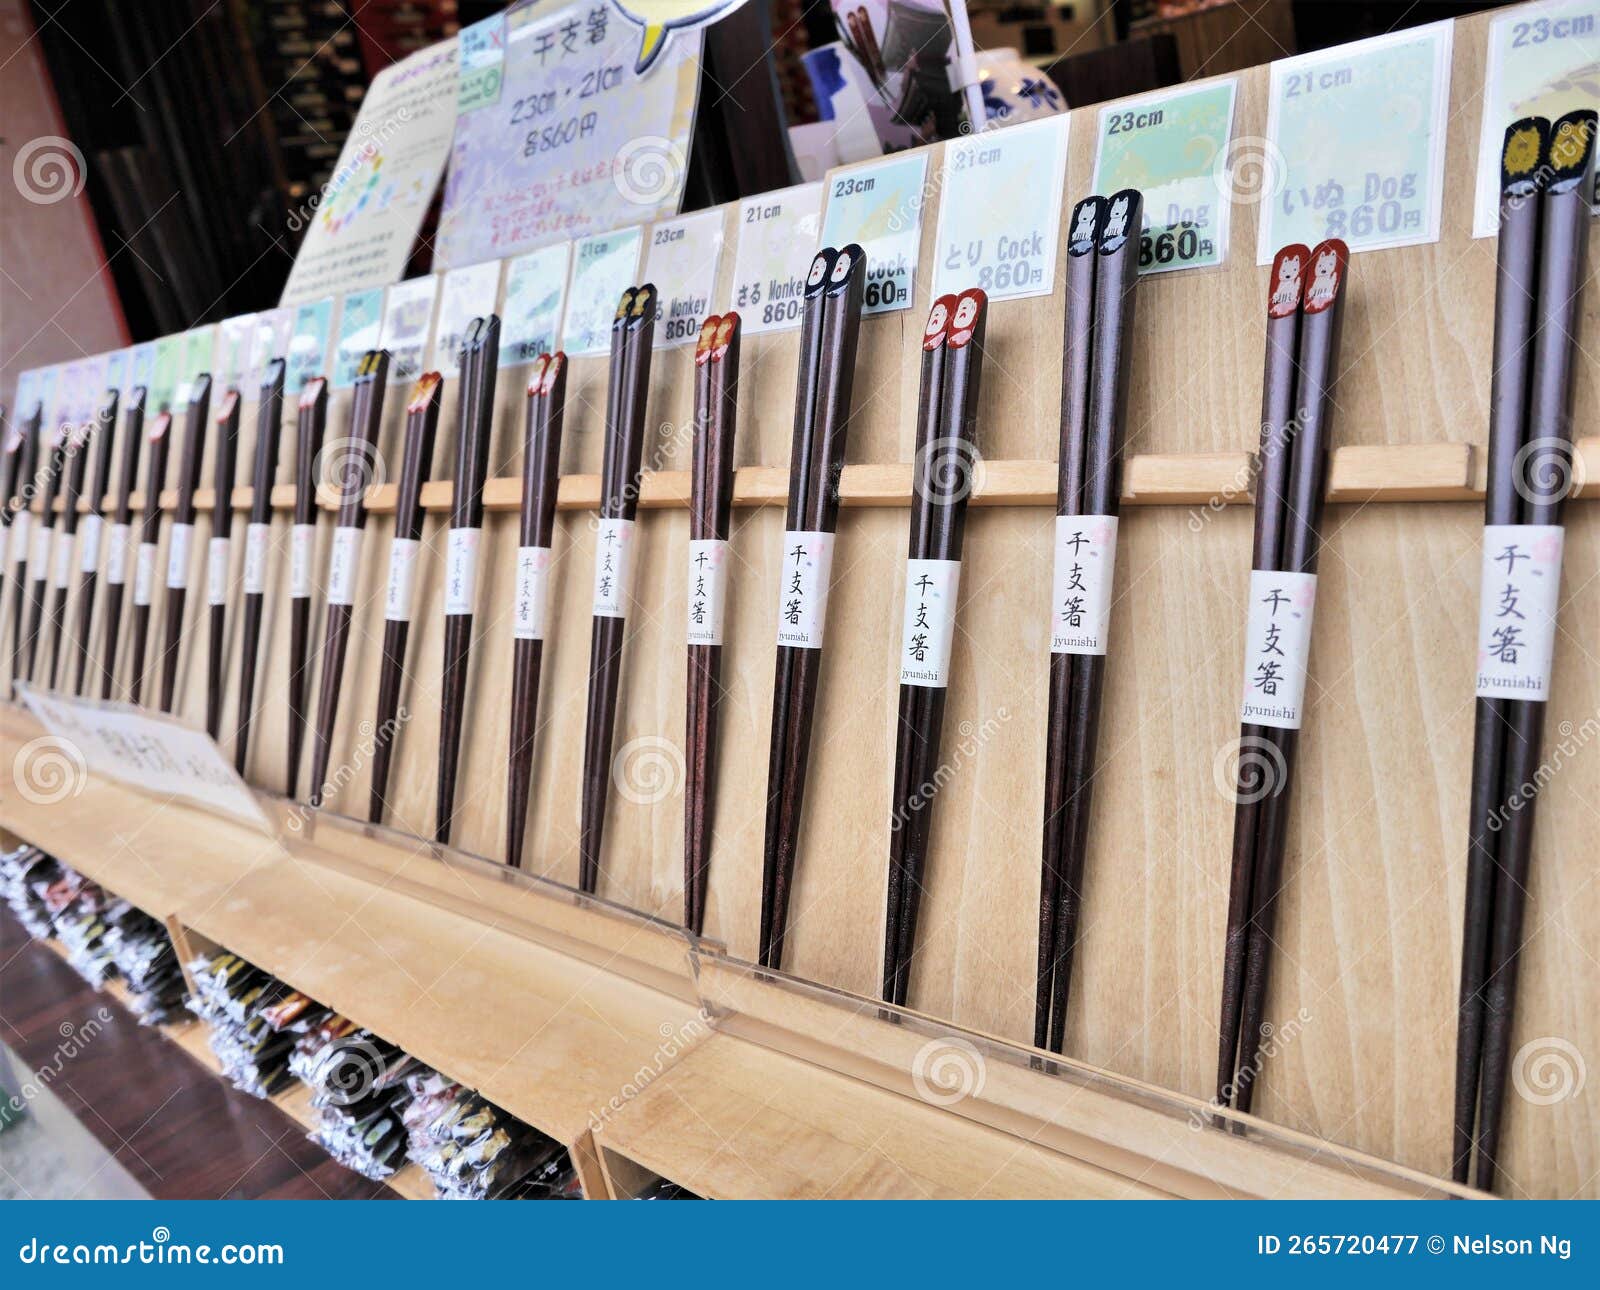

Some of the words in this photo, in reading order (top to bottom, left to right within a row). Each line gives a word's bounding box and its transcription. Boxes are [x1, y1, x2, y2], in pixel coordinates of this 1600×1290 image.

[1511, 14, 1594, 48] 23cm
[1286, 68, 1352, 98] 21cm
[1108, 110, 1164, 135] 23cm
[955, 148, 1001, 171] 21cm
[835, 178, 875, 198] 23cm
[1364, 172, 1418, 203] Dog
[746, 205, 781, 223] 21cm
[1166, 203, 1210, 231] Dog
[1325, 201, 1421, 239] 860円
[655, 229, 685, 245] 23cm
[945, 239, 983, 270] とり
[997, 230, 1044, 262] Cock
[867, 253, 907, 281] Cock
[977, 260, 1043, 291] 860円
[670, 297, 708, 318] Monkey
[864, 280, 907, 307] 60円
[692, 551, 708, 624] 干支箸
[784, 544, 807, 625] 干支箸
[1061, 531, 1090, 628] 干支箸
[909, 574, 934, 662] 干支箸
[1488, 544, 1531, 664] 干支箸
[1053, 634, 1097, 648] jyunishi
[1254, 588, 1291, 696] 干支箸
[1478, 672, 1542, 690] jyunishi
[1243, 702, 1296, 720] jyunishi
